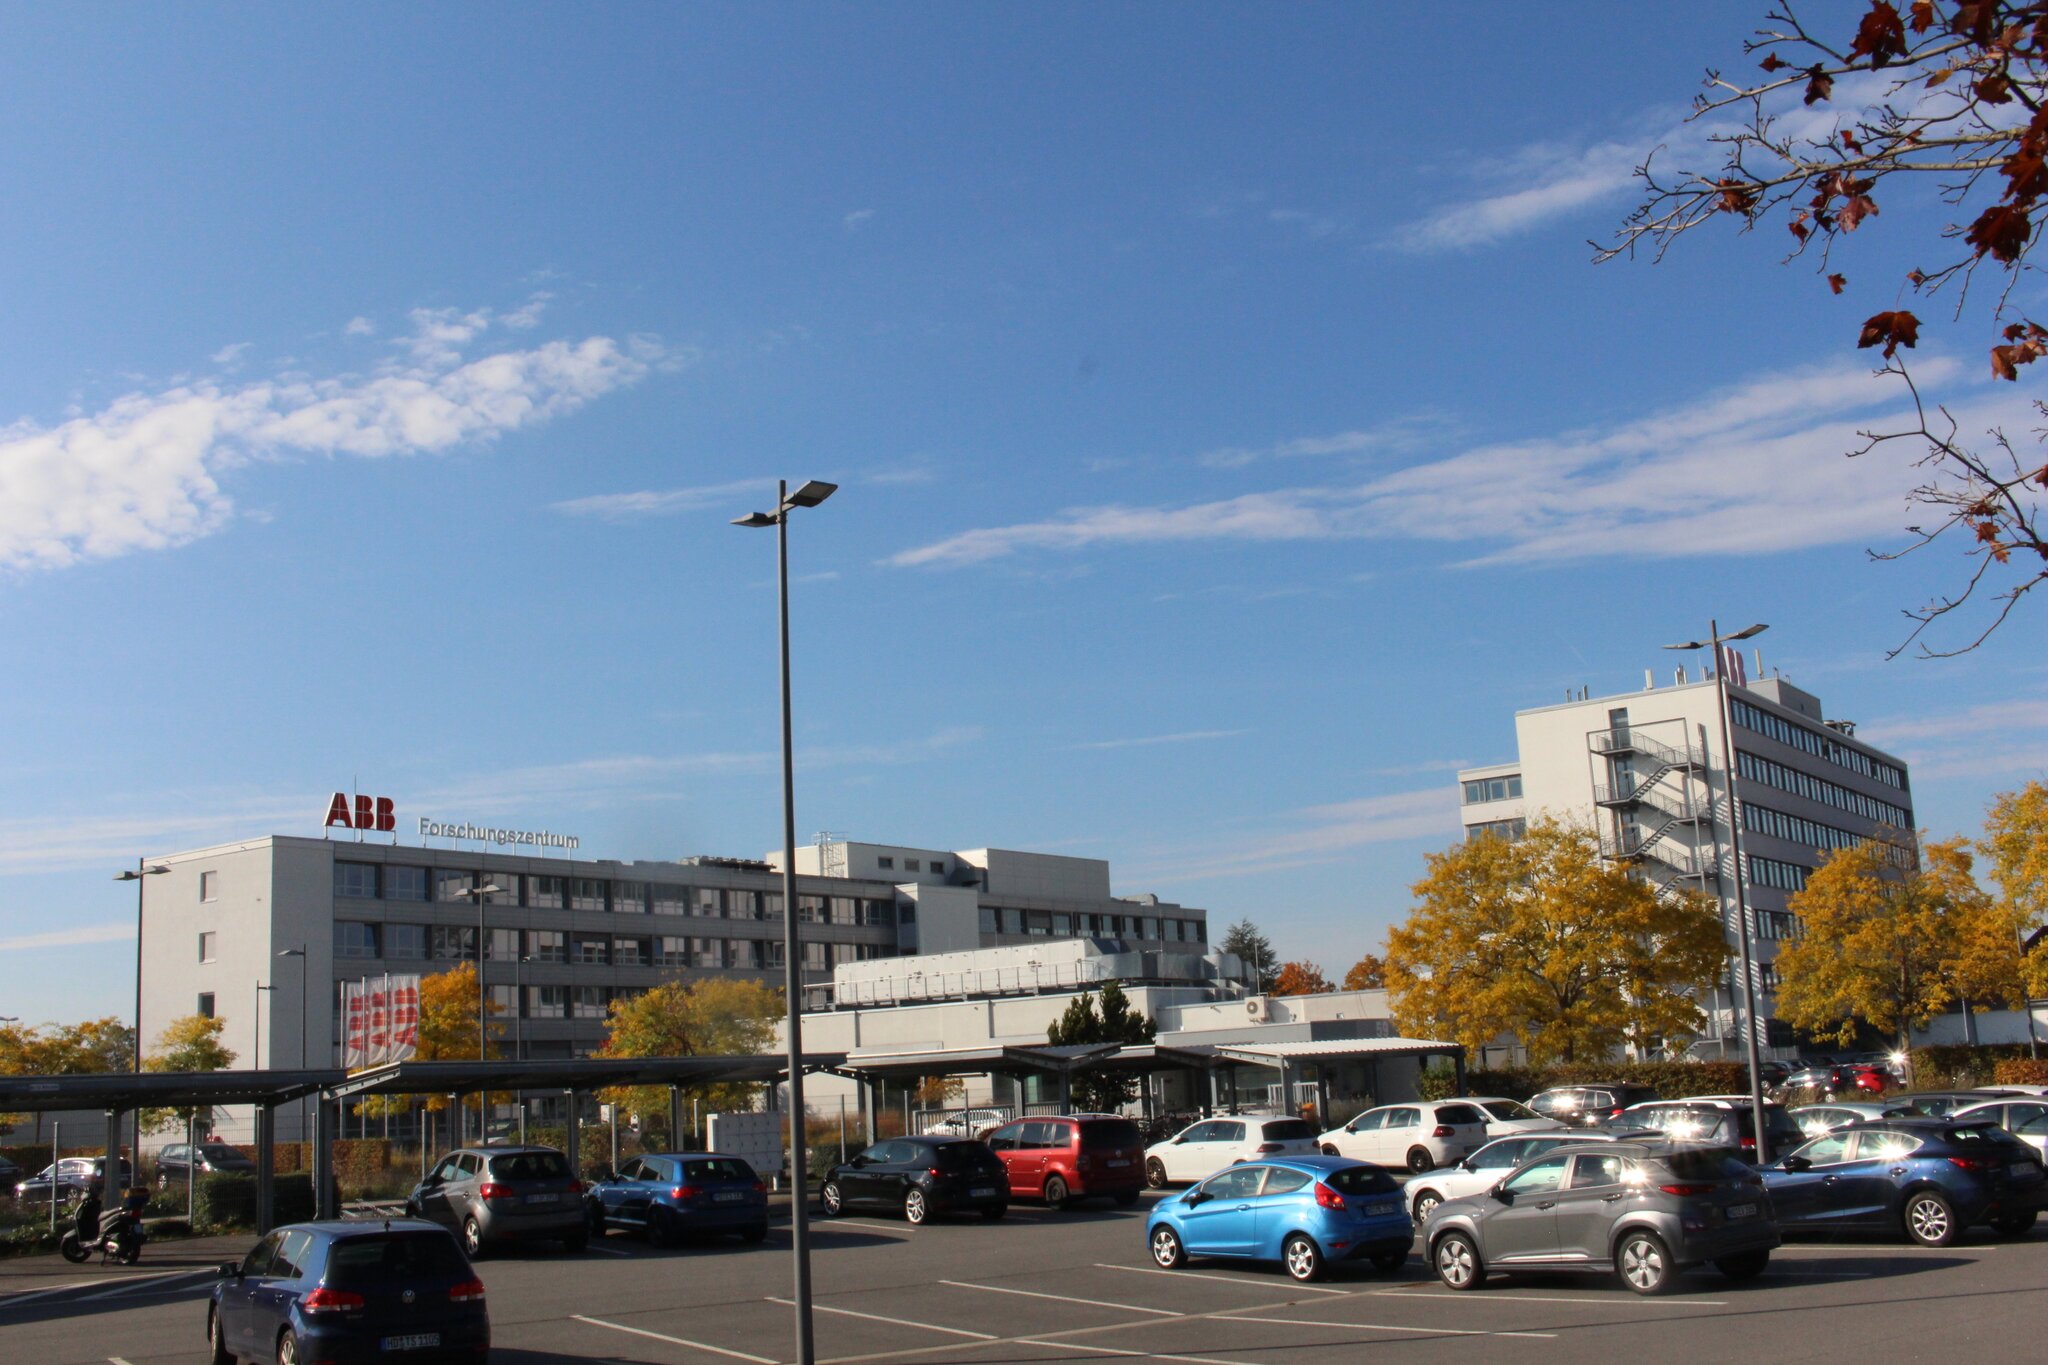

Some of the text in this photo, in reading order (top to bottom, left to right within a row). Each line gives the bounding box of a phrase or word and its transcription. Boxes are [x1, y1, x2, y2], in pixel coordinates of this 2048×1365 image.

[324, 792, 396, 832] ABB
[418, 817, 580, 849] Forschungszentrum
[394, 987, 418, 1047] ABB
